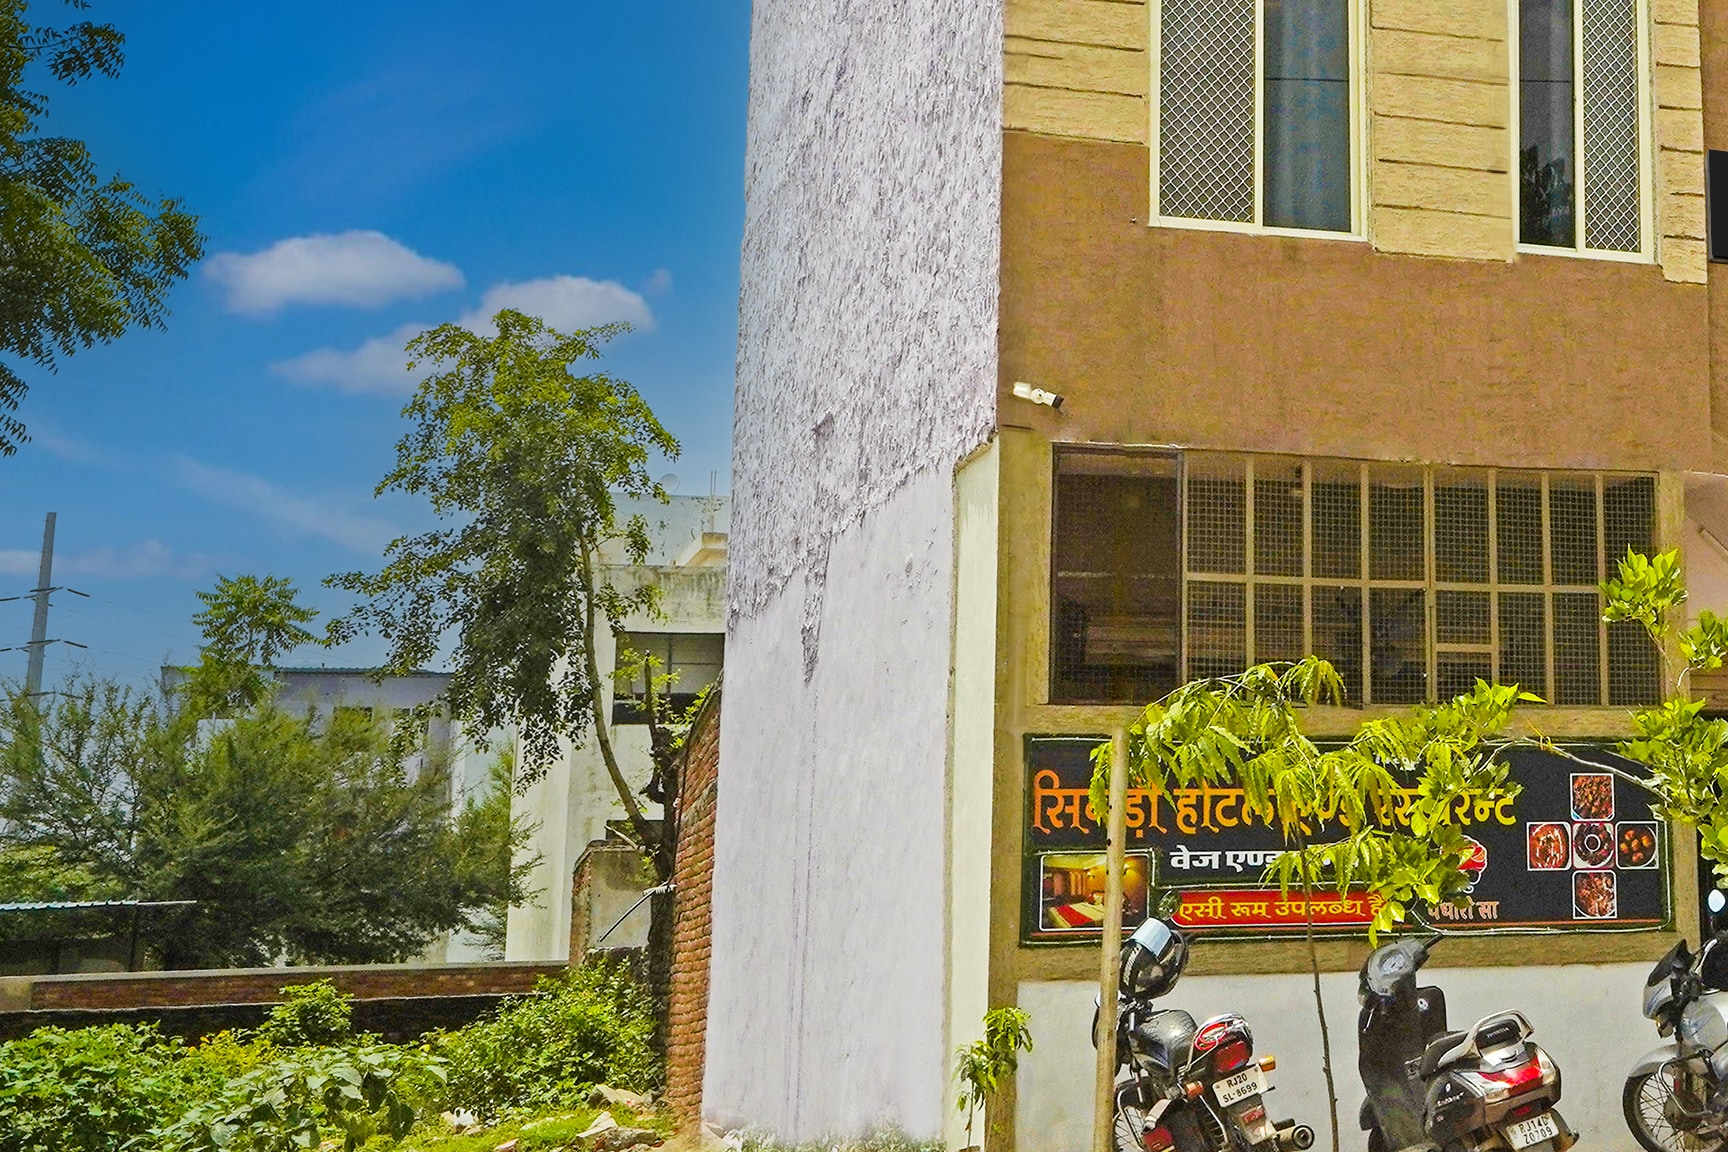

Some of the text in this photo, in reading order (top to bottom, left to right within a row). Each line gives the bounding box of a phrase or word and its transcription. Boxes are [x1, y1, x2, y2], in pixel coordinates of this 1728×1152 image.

[1170, 844, 1222, 871] वेज
[1179, 896, 1227, 921] एसी
[1230, 900, 1272, 921] रूम
[1476, 901, 1500, 920] सा
[1226, 1072, 1248, 1088] RJ20
